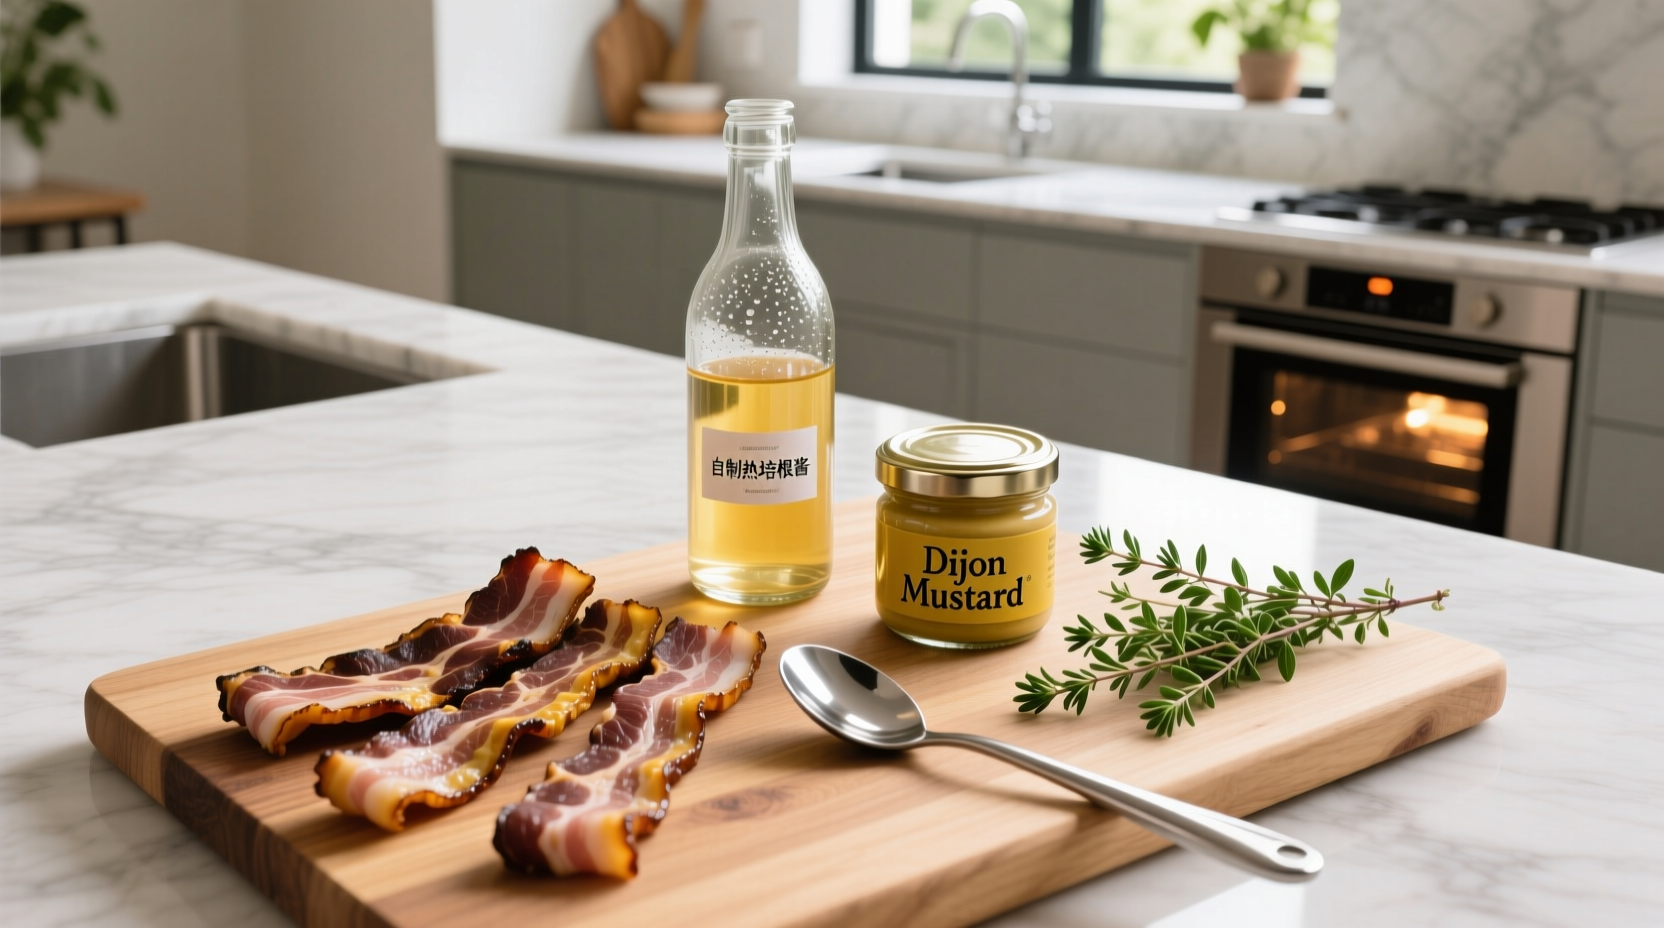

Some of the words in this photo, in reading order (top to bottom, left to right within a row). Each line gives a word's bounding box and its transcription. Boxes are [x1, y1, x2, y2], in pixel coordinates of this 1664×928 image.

[712, 456, 810, 480] 自制热培根酱
[923, 545, 1006, 586] Dijon
[901, 573, 1023, 610] Mustard
